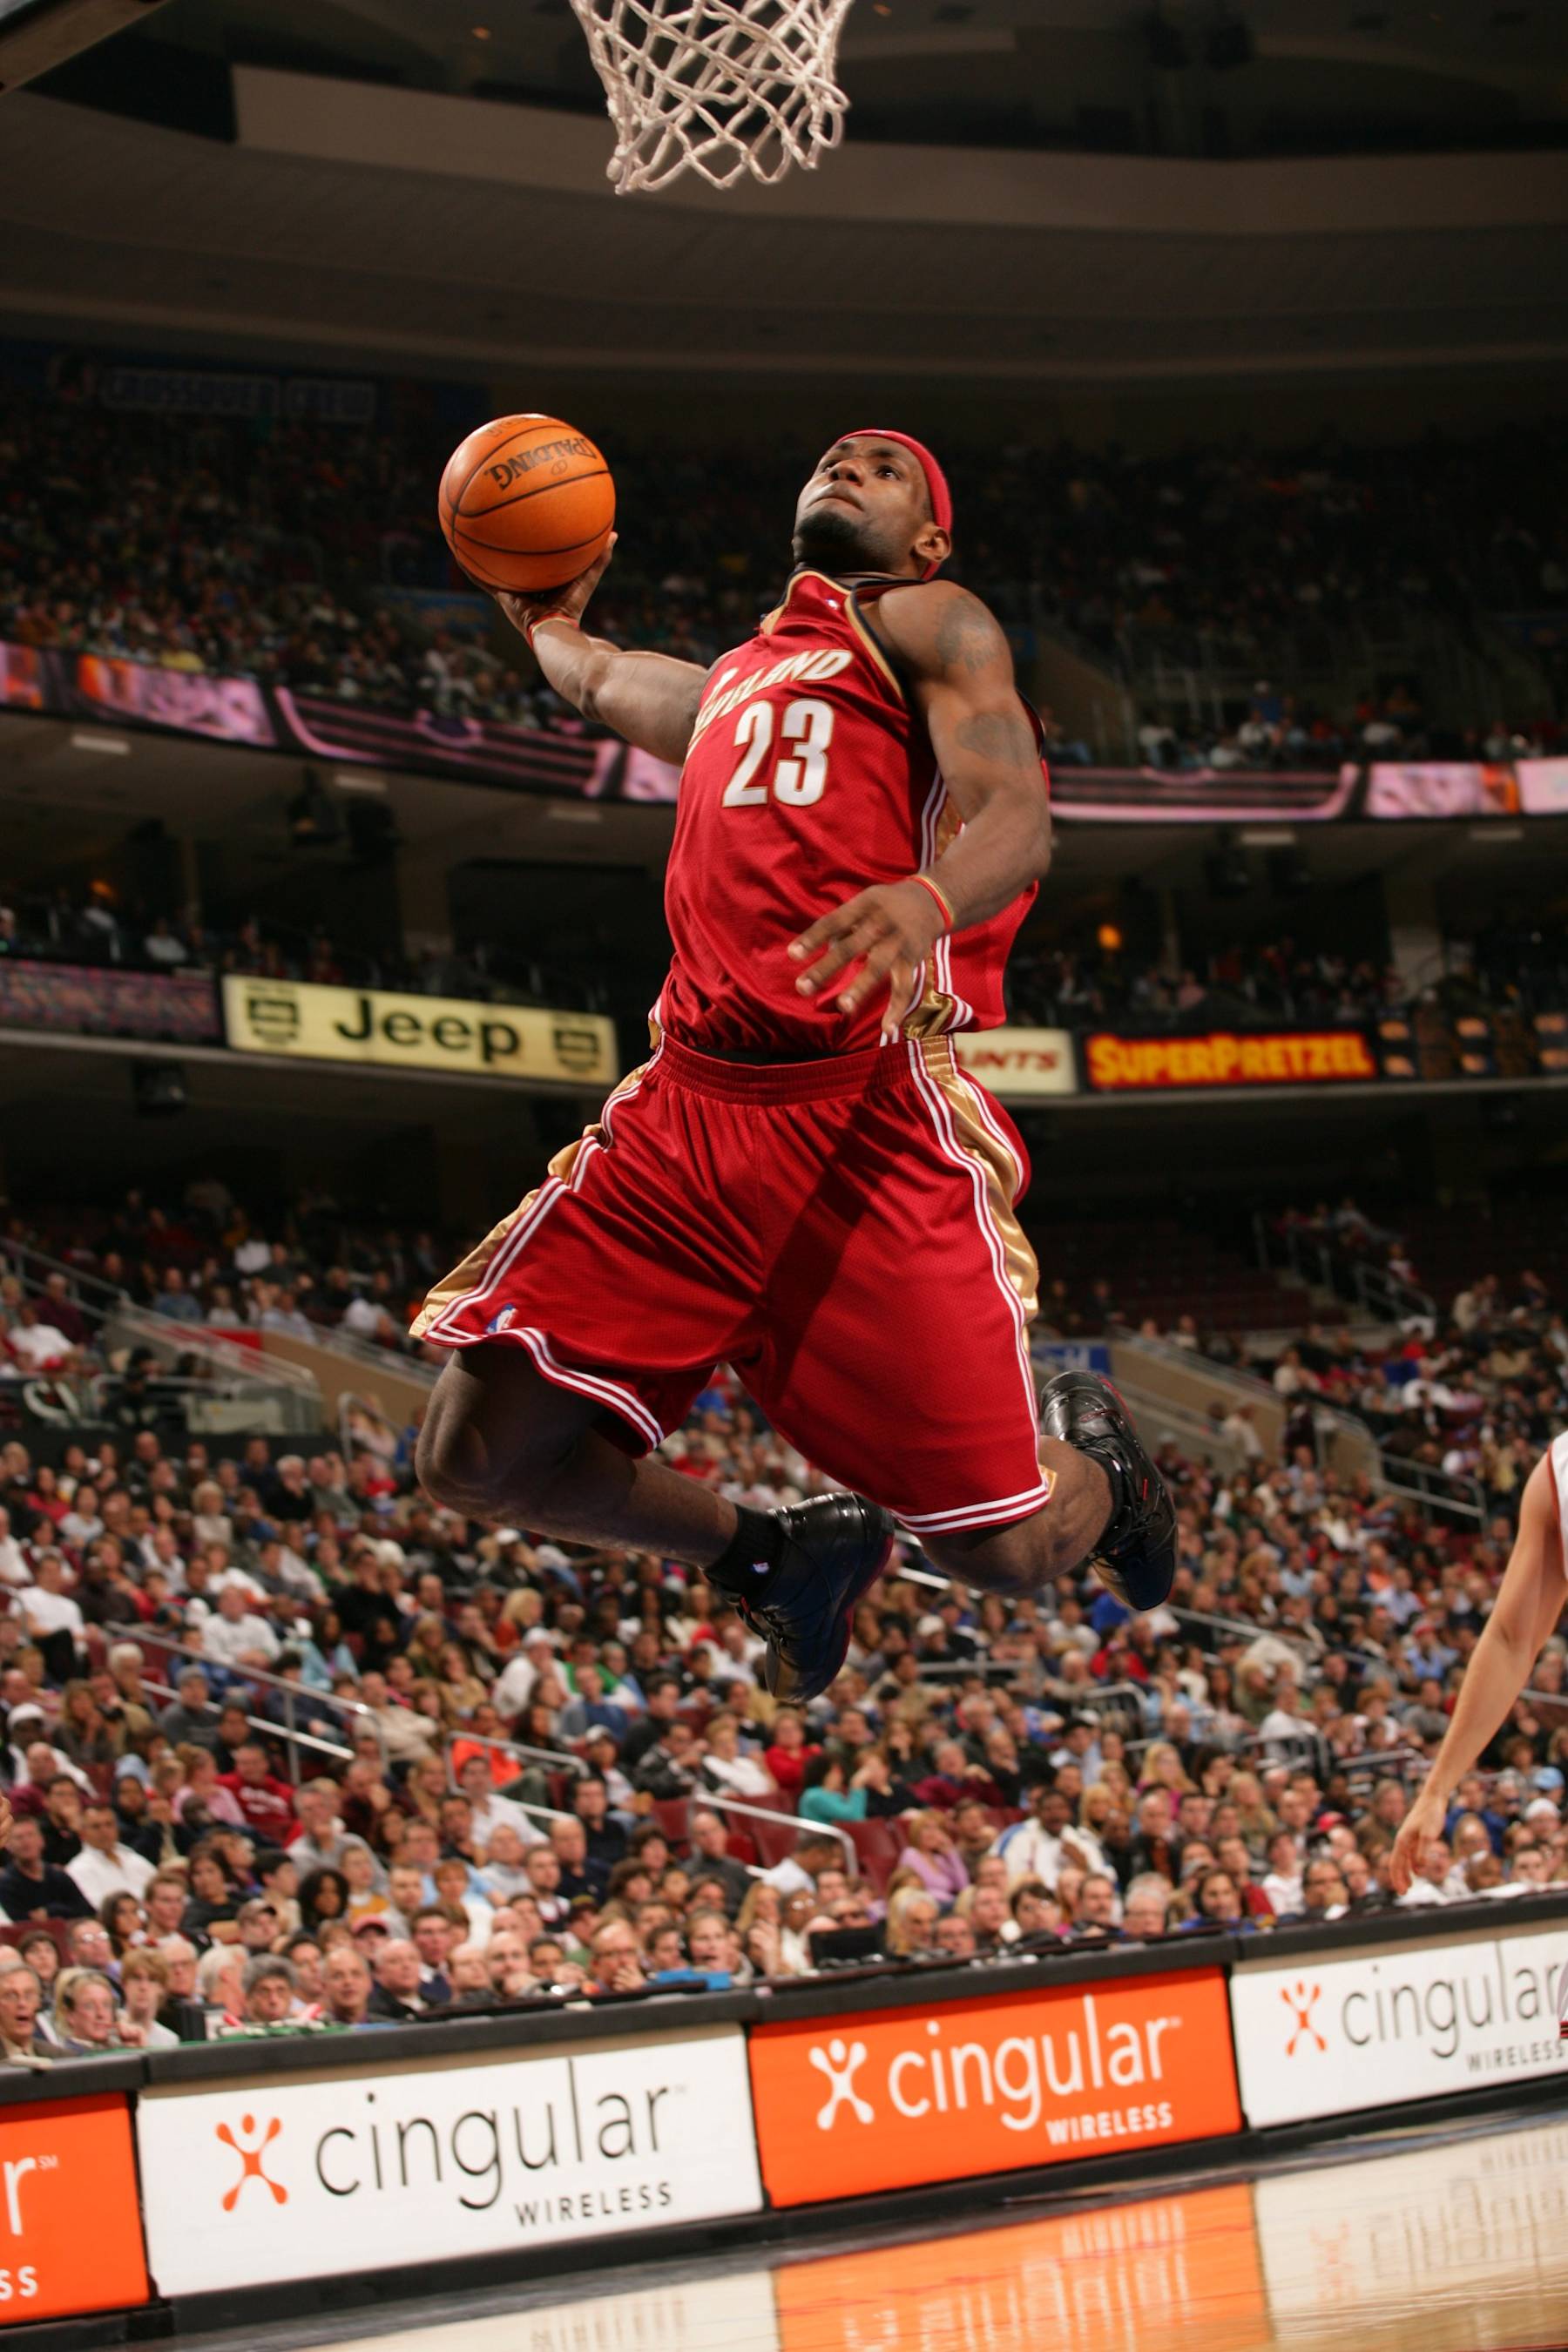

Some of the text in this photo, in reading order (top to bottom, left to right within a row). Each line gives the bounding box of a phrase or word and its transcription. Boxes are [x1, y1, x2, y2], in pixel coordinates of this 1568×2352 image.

[486, 437, 598, 490] SPALDING
[722, 698, 835, 808] 23
[335, 993, 522, 1063] Jeep
[1090, 1035, 1374, 1084] SUPERPRETZEL
[1342, 1940, 1560, 2058] cingular
[888, 1993, 1169, 2131] cingular
[1467, 2038, 1565, 2072] WIRELESS
[315, 2057, 669, 2211] cingular
[1045, 2101, 1173, 2146] WIRELESS
[513, 2181, 673, 2227] WIRELESS
